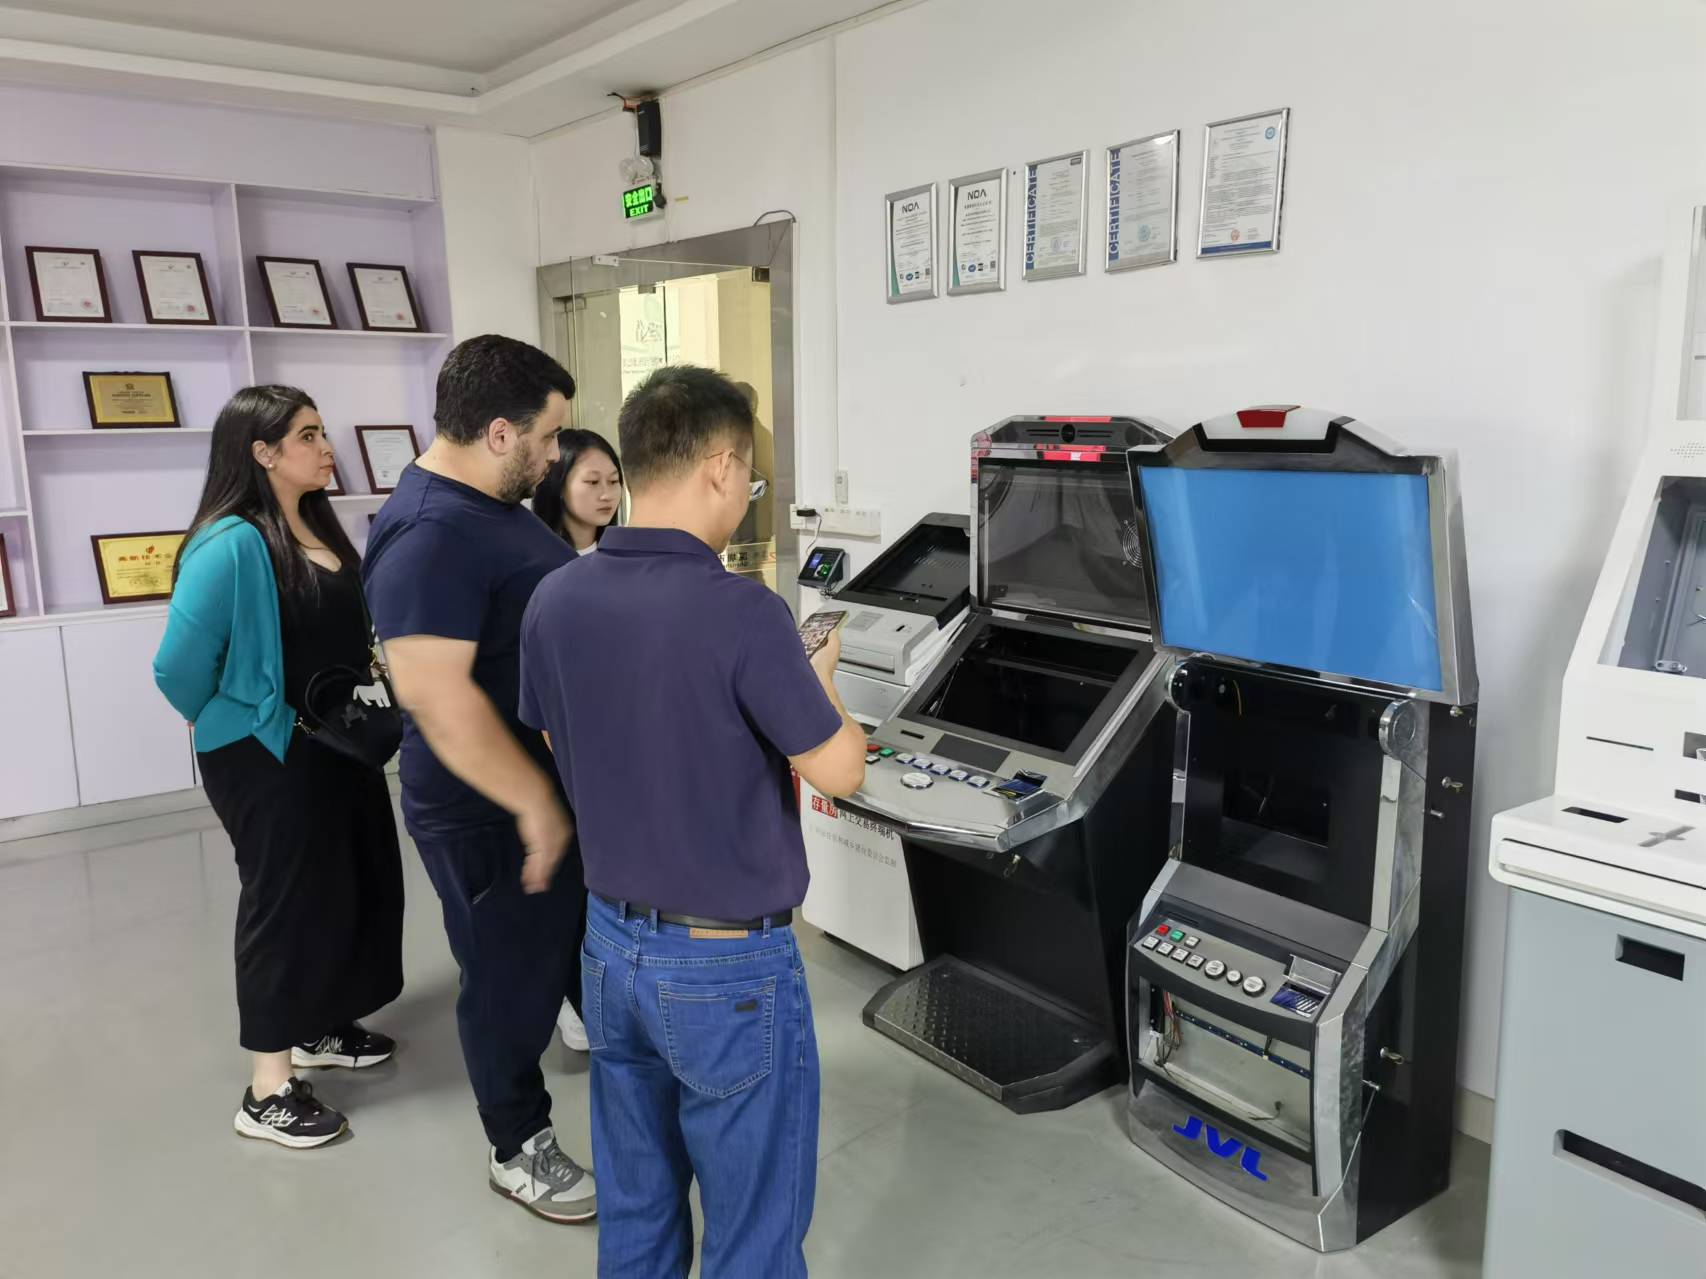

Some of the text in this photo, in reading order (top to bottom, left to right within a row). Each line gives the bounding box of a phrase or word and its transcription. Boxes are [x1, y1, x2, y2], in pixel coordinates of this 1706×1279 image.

[629, 204, 649, 217] EXIT
[1109, 153, 1120, 254] CERTIFICATE
[1172, 1115, 1268, 1182] JVL
